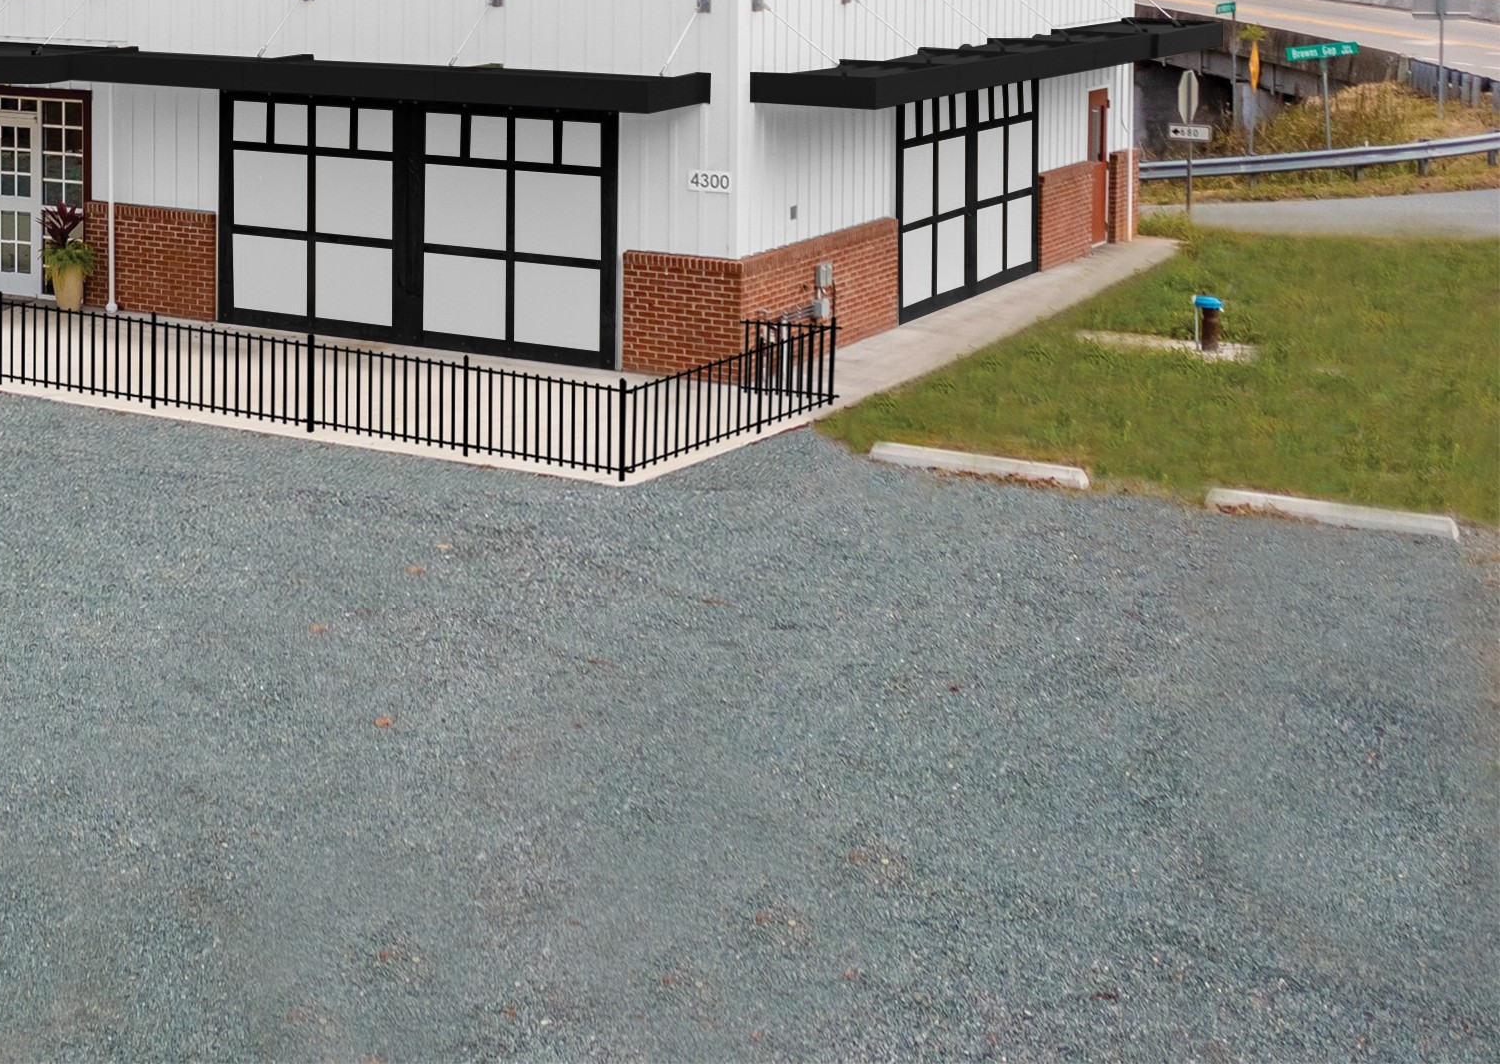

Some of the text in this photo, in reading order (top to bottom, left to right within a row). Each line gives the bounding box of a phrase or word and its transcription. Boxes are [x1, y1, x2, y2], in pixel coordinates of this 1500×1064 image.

[1292, 48, 1318, 59] Browns
[1322, 45, 1337, 56] Gap
[690, 173, 729, 189] 4300
